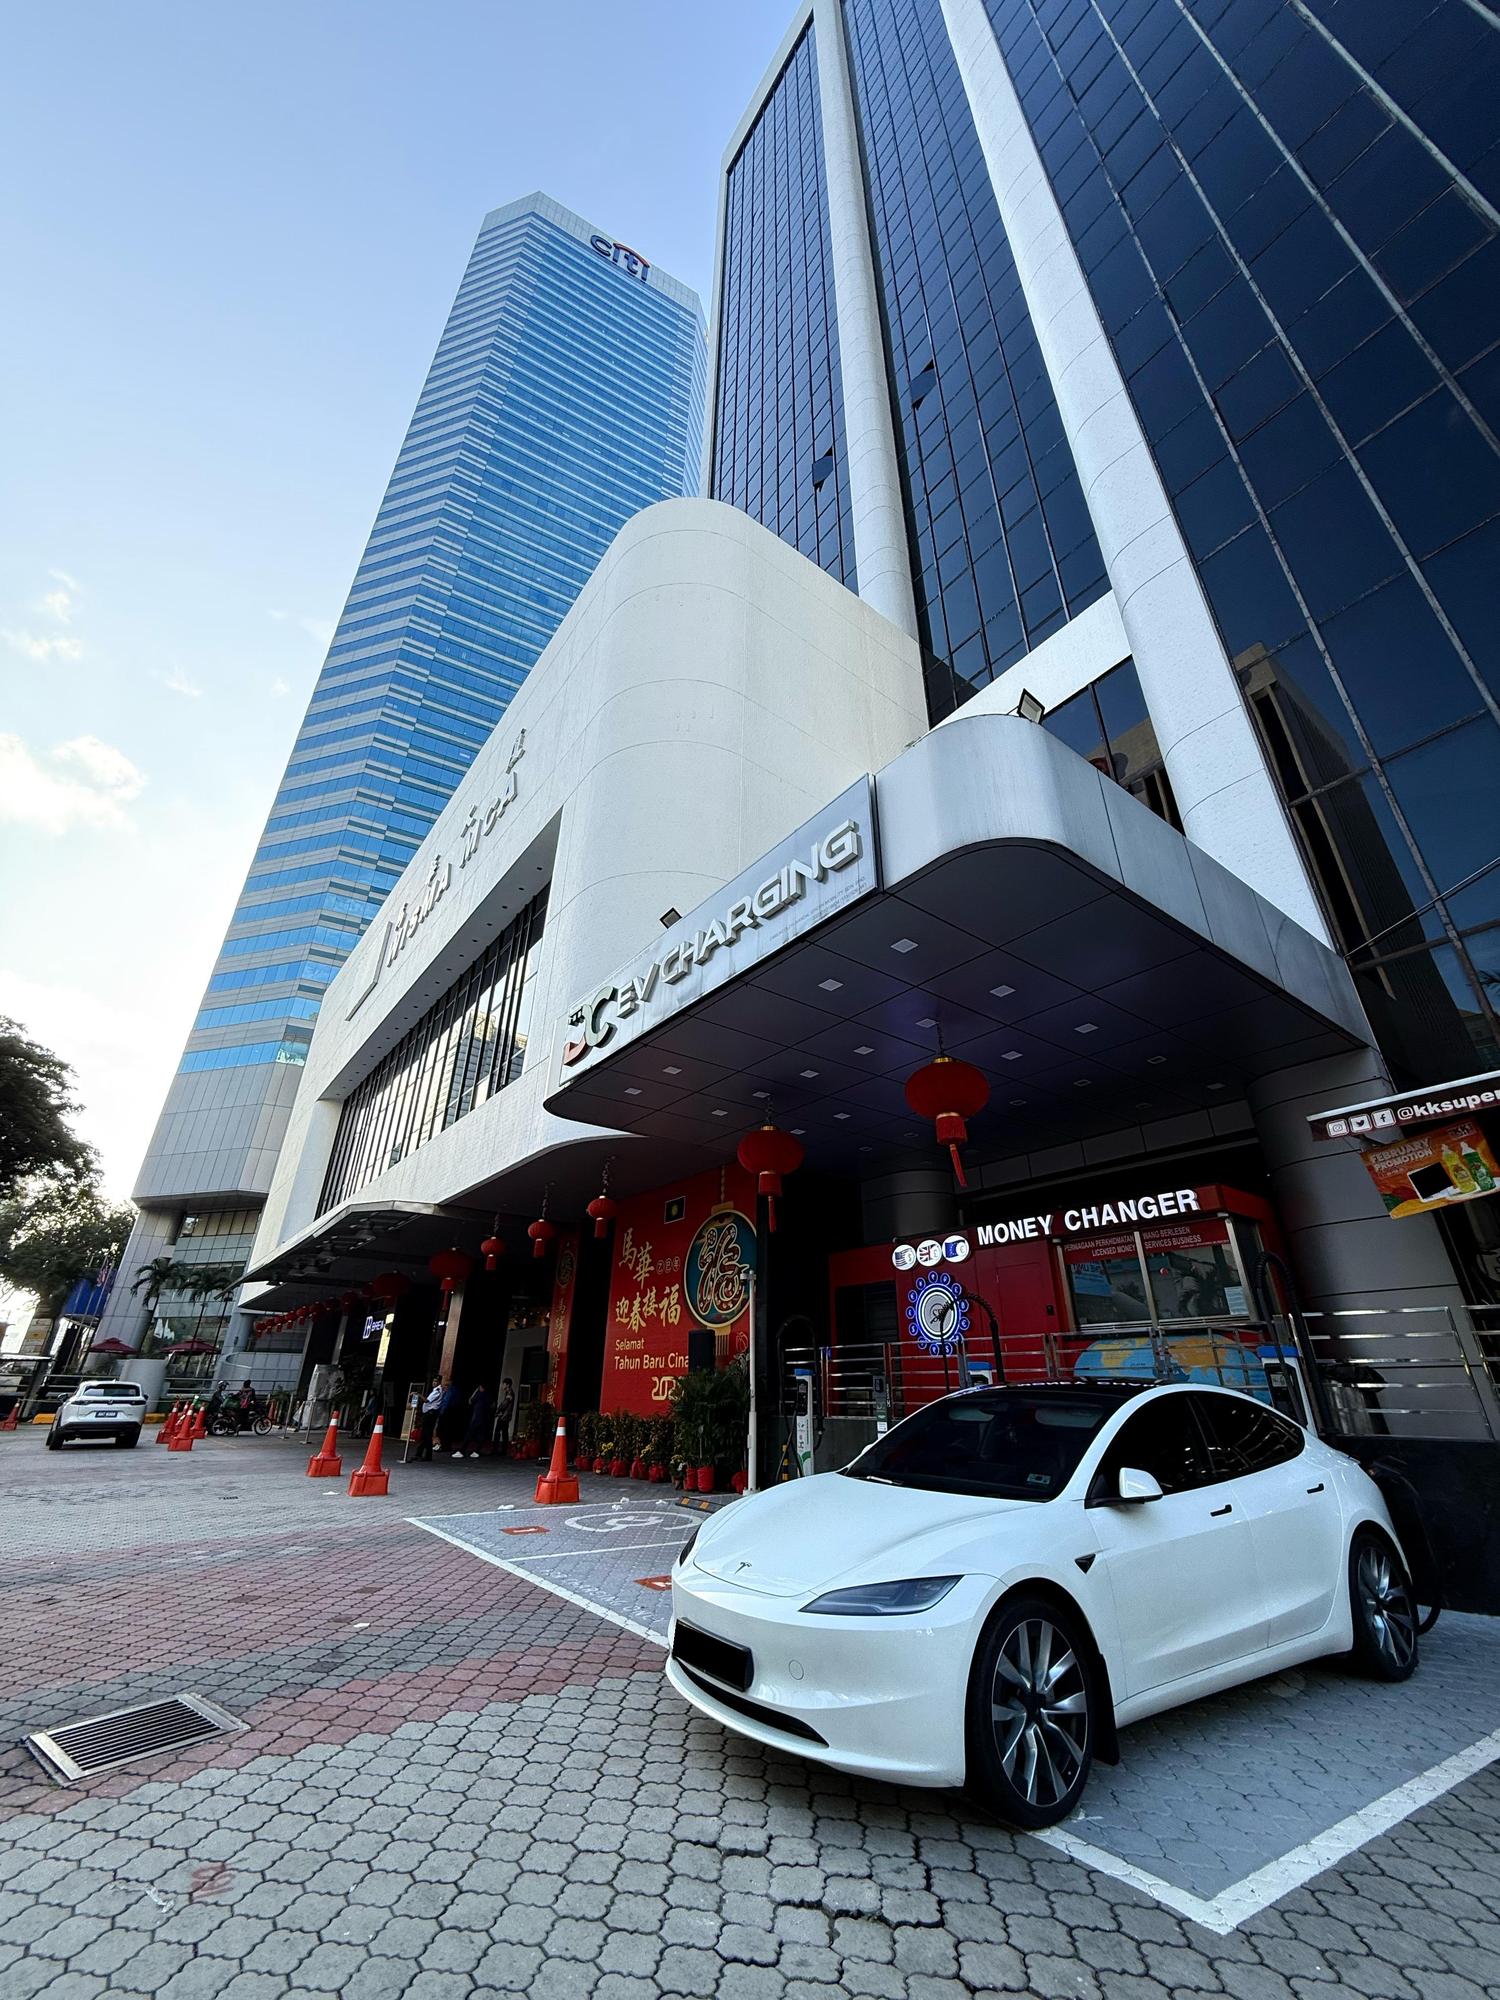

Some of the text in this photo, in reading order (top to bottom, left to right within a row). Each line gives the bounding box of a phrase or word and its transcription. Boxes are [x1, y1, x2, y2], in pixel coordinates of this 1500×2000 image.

[459, 771, 518, 869] MCA
[1370, 1136, 1432, 1164] FEBRUARY
[1374, 1148, 1433, 1173] PROMOTION
[977, 1189, 1199, 1246] MONEY CHANGER
[1092, 1246, 1117, 1257] LICENSED
[1117, 1244, 1136, 1255] MONEY
[1144, 1238, 1173, 1250] SERVICES
[1173, 1234, 1202, 1247] BUSINESS
[615, 1284, 681, 1333] 迎春接福
[615, 1337, 645, 1351] Selamat
[614, 1352, 689, 1370] Tahun Baru Cina
